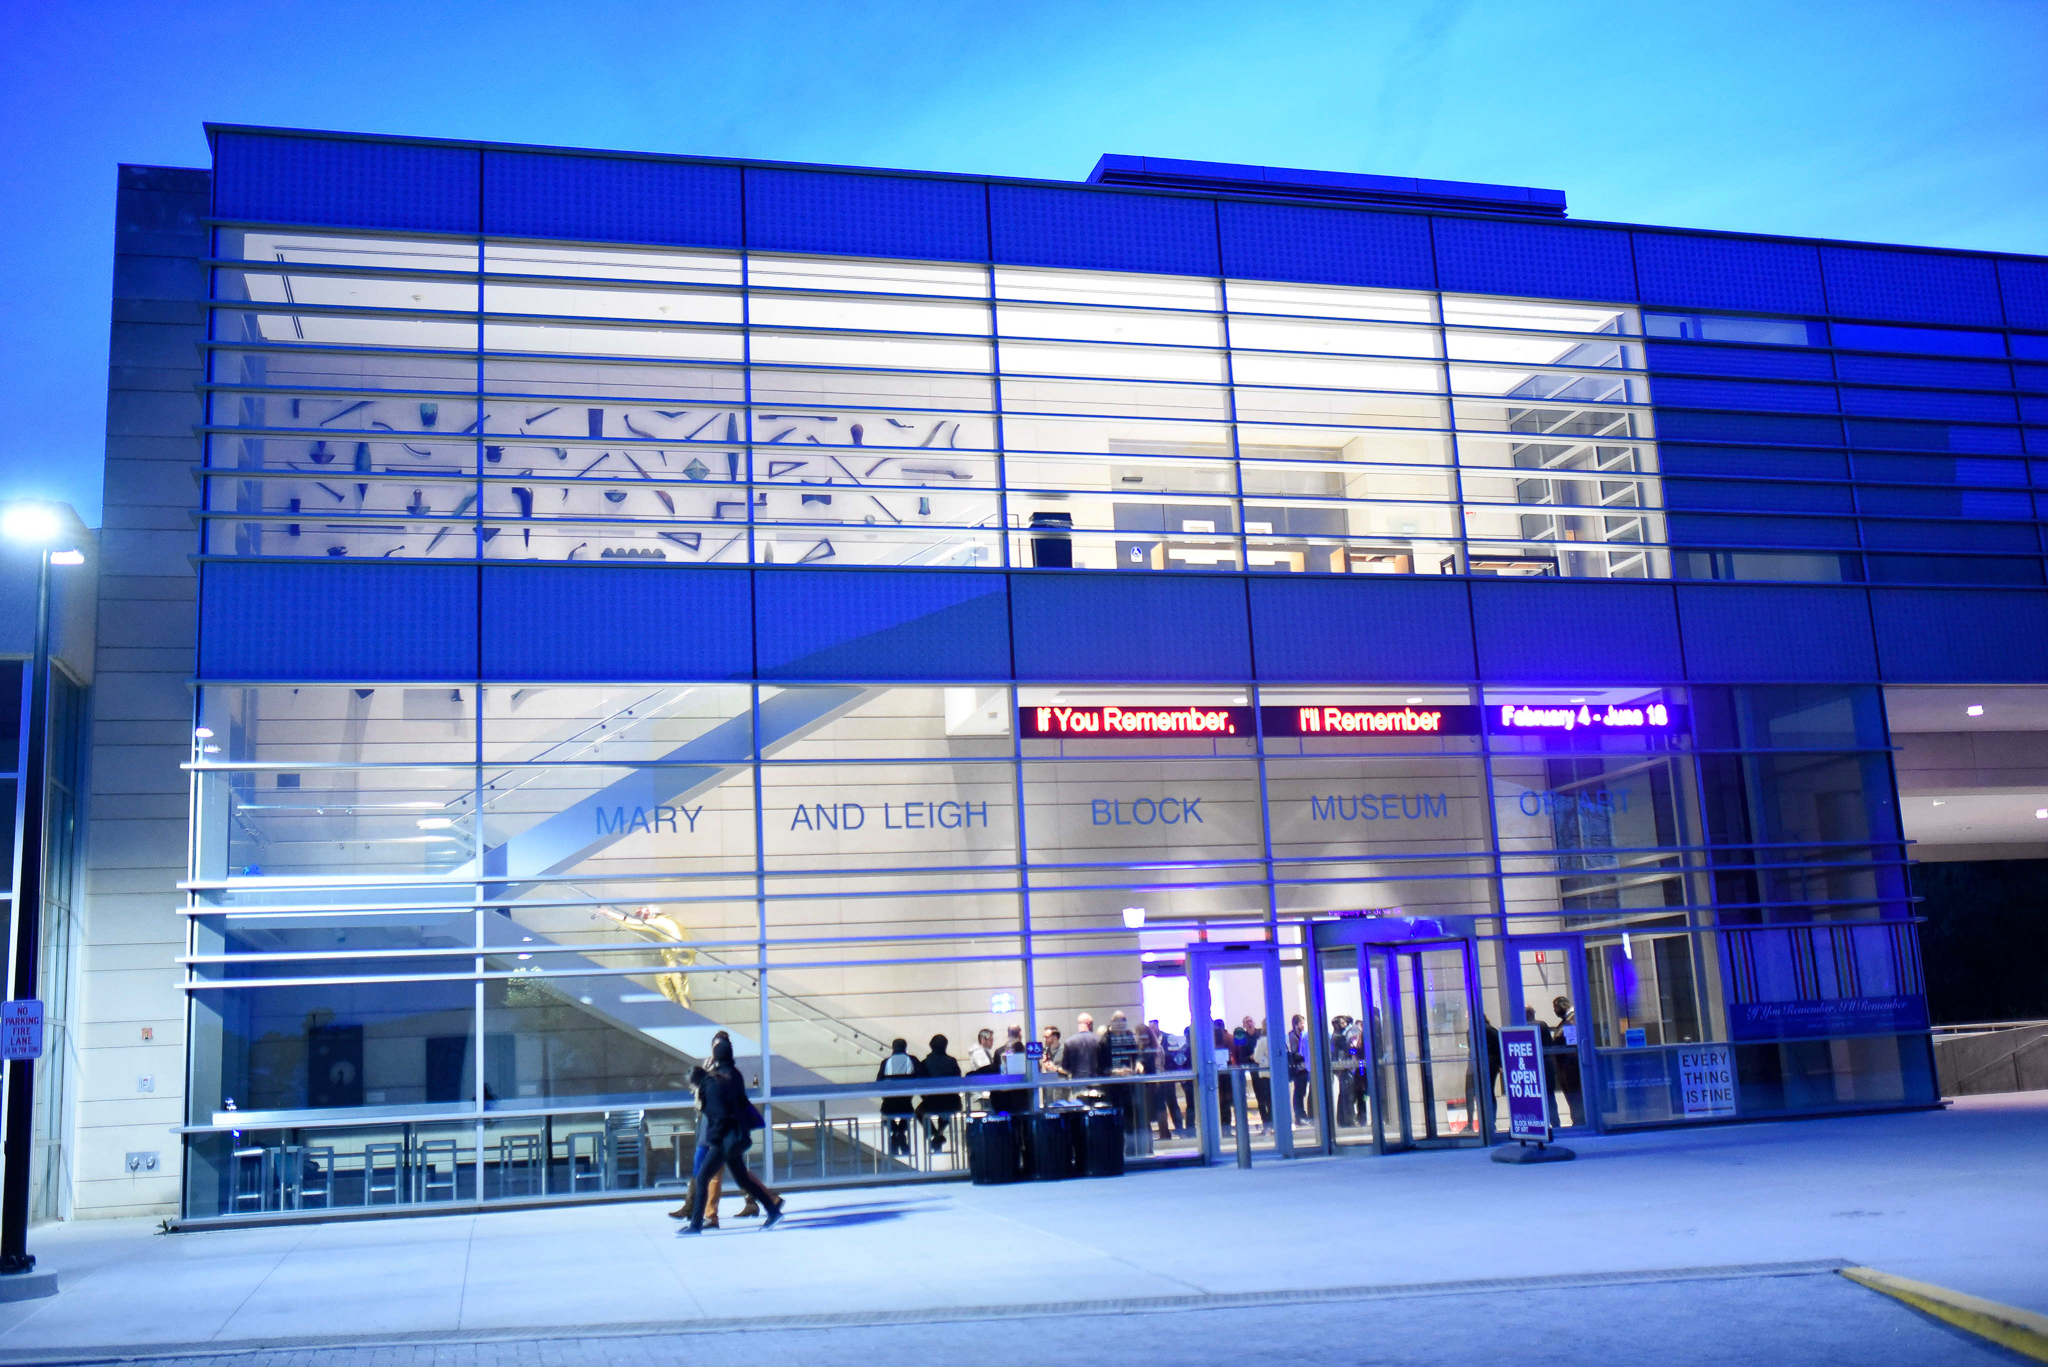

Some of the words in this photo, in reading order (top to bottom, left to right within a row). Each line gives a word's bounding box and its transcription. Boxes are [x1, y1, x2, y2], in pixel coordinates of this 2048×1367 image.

[1036, 706, 1051, 732] If
[1054, 707, 1099, 732] You
[1103, 706, 1235, 734] Remember,
[1300, 707, 1321, 732] I'll
[1324, 706, 1442, 732] Remember
[1501, 705, 1575, 731] February
[1577, 704, 1591, 727] 4
[1603, 704, 1644, 726] June
[595, 805, 704, 835] MARY
[791, 803, 865, 832] AND
[884, 800, 988, 830] LEIGH
[1091, 797, 1204, 826] BLOCK
[1310, 793, 1448, 821] MUSEUM
[1520, 790, 1558, 817] OF
[1578, 789, 1632, 816] ART
[17, 1007, 28, 1015] NO
[1758, 1004, 1781, 1021] You
[1783, 1002, 1838, 1016] Remember,
[1857, 998, 1908, 1013] Remember
[5, 1017, 39, 1025] PARKING
[13, 1027, 30, 1035] FIRE
[11, 1036, 31, 1045] LANE
[1508, 1043, 1534, 1057] FREE
[1518, 1057, 1526, 1070] &
[1682, 1052, 1727, 1068] EVERY
[1511, 1070, 1537, 1084] OPEN
[1684, 1070, 1729, 1086] THING
[1510, 1084, 1522, 1098] TO
[1524, 1084, 1542, 1098] ALL
[1686, 1090, 1698, 1104] IS
[1701, 1088, 1733, 1103] FINE
